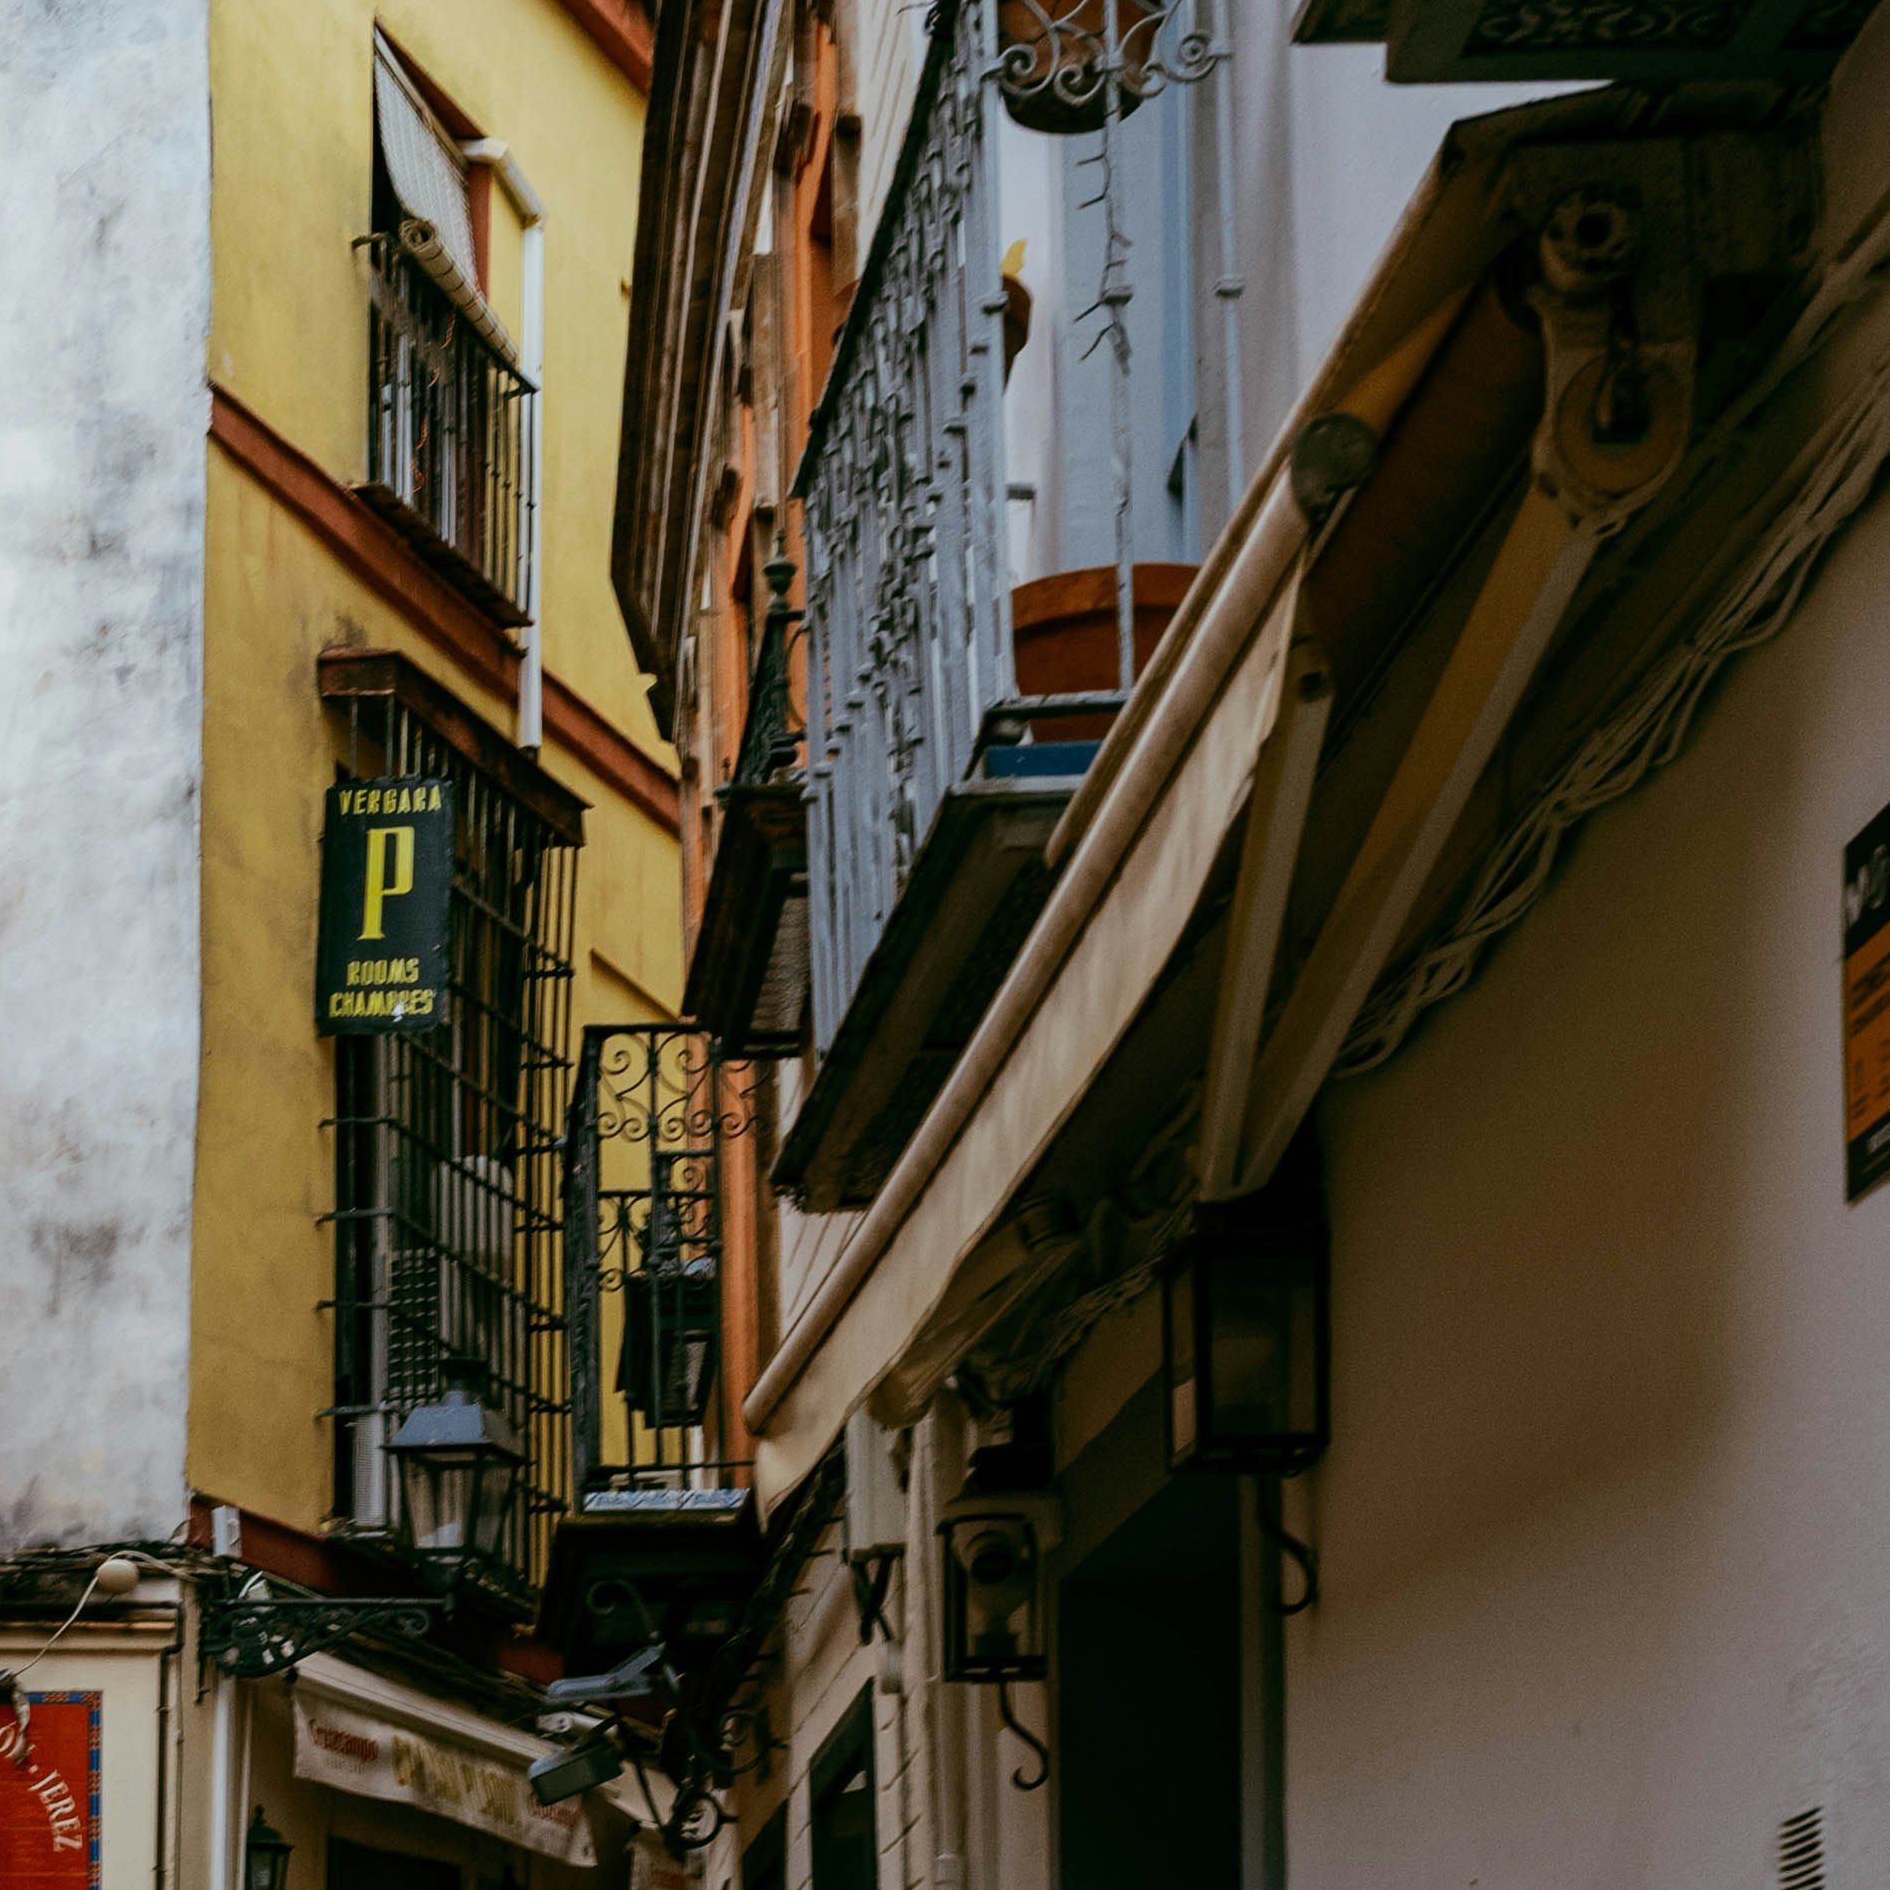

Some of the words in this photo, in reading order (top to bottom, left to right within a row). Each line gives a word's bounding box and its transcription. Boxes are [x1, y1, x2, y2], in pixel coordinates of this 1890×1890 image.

[338, 784, 443, 816] VERGARA
[356, 825, 416, 942] P
[346, 957, 420, 987] ROOMS
[27, 1768, 84, 1853] JEREZ
